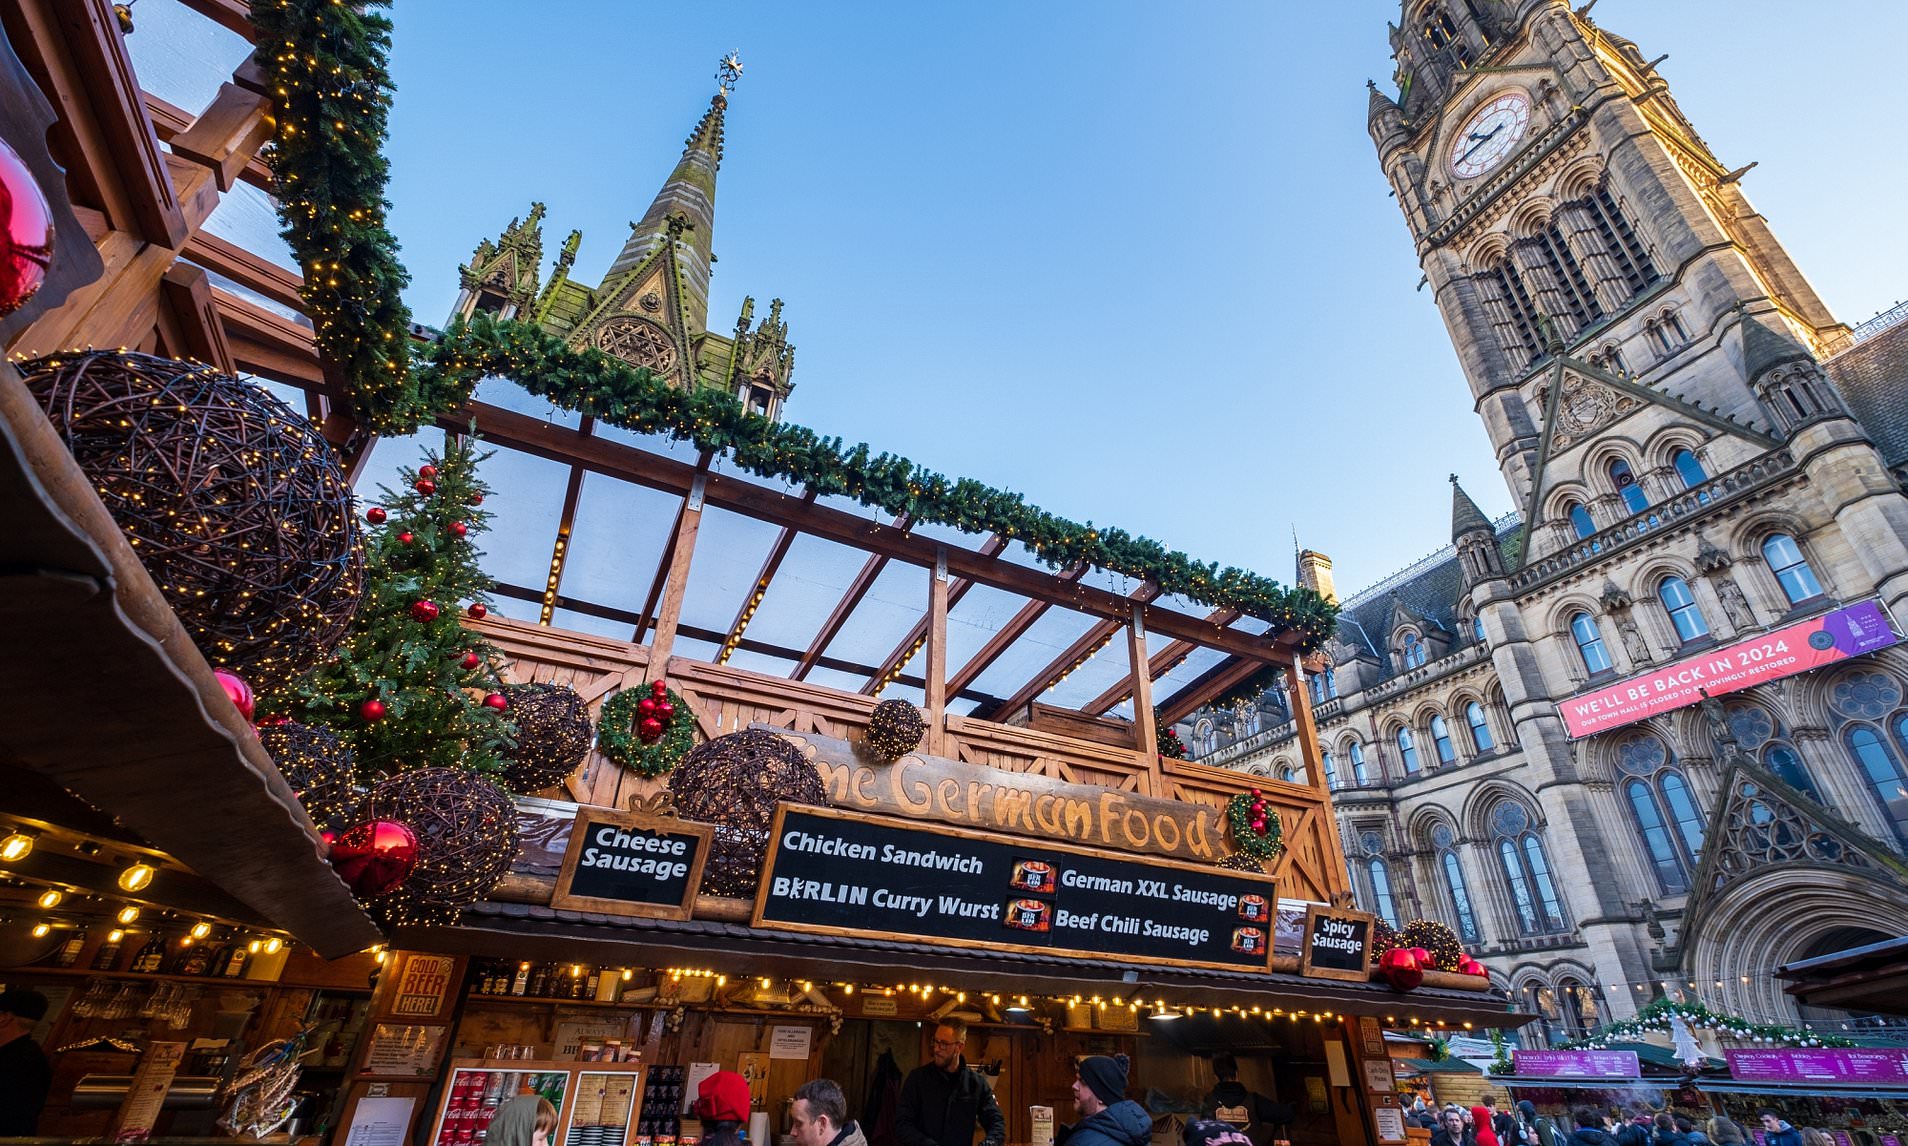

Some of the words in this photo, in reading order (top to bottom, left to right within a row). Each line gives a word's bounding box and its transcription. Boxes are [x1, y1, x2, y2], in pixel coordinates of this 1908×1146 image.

[1627, 687, 1650, 701] BE
[1654, 667, 1704, 693] BACK
[1709, 658, 1733, 675] IN
[1737, 639, 1789, 666] 2024
[1581, 716, 1598, 728] OUR
[1599, 709, 1619, 722] TOWN
[1620, 704, 1639, 717] HALL
[1640, 701, 1648, 710] IS
[1648, 692, 1680, 706] CLOSED
[1680, 687, 1692, 697] TO
[1705, 671, 1747, 689] LOVINGLY
[1749, 655, 1797, 675] RESTORED
[889, 755, 1093, 840] German
[1101, 791, 1212, 859] Food
[596, 827, 687, 856] Cheese
[783, 831, 877, 861] Chicken
[881, 844, 984, 875] Sandwich
[581, 847, 688, 881] Sausage
[872, 888, 933, 917] Curry
[938, 895, 1000, 920] Wurst
[1061, 869, 1133, 895] German
[1135, 879, 1169, 899] XXL
[1172, 884, 1238, 911] Sausage
[1055, 909, 1098, 931] Beef
[1100, 914, 1140, 935] Chili
[1142, 920, 1210, 946] Sausage
[1312, 933, 1363, 954] Sausage
[1322, 919, 1356, 939] Spicy
[409, 958, 438, 974] COLD
[403, 974, 445, 995] BEER
[400, 997, 434, 1013] HERE!
